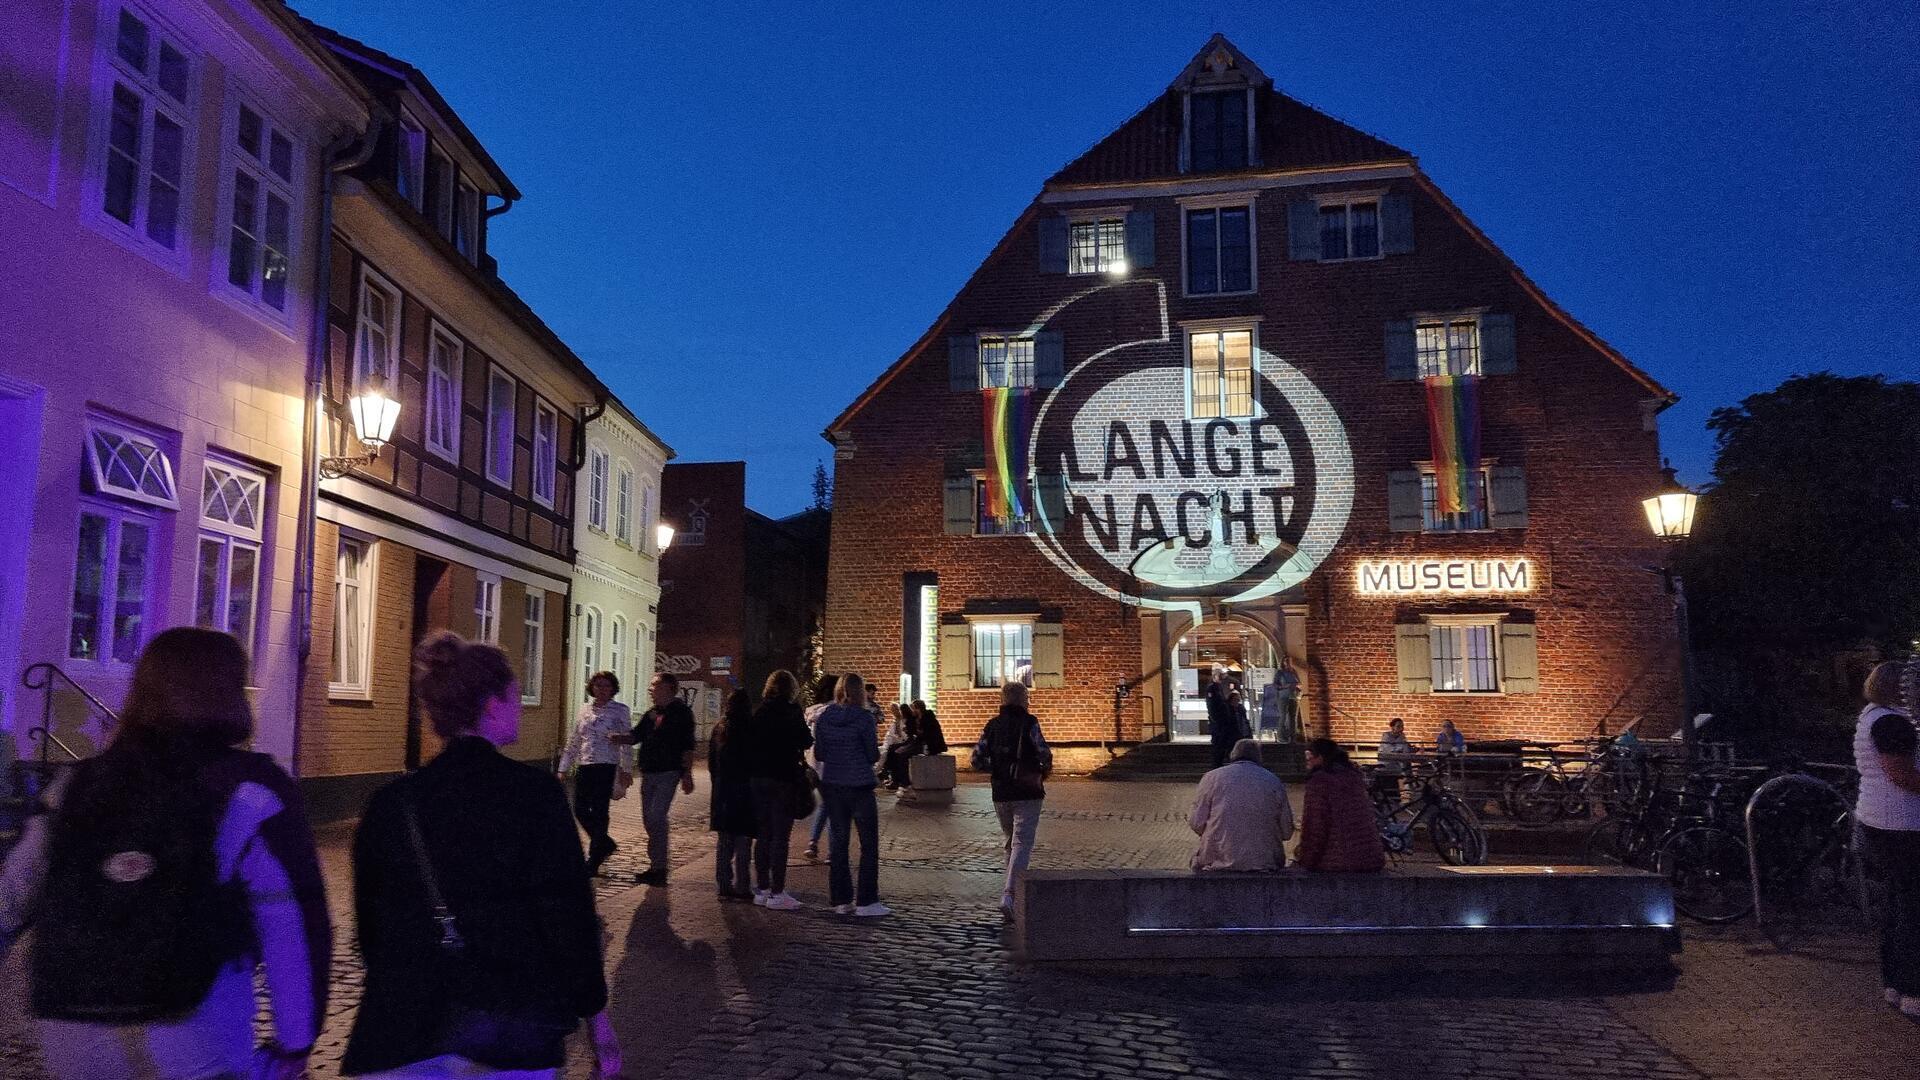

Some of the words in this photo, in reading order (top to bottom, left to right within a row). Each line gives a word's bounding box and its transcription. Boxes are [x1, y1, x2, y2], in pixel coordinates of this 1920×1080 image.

[1062, 418, 1282, 481] LANGE
[1073, 485, 1295, 552] NACHT
[1362, 562, 1528, 591] MUSEUM
[926, 589, 938, 712] HWEDENSPEICHER
